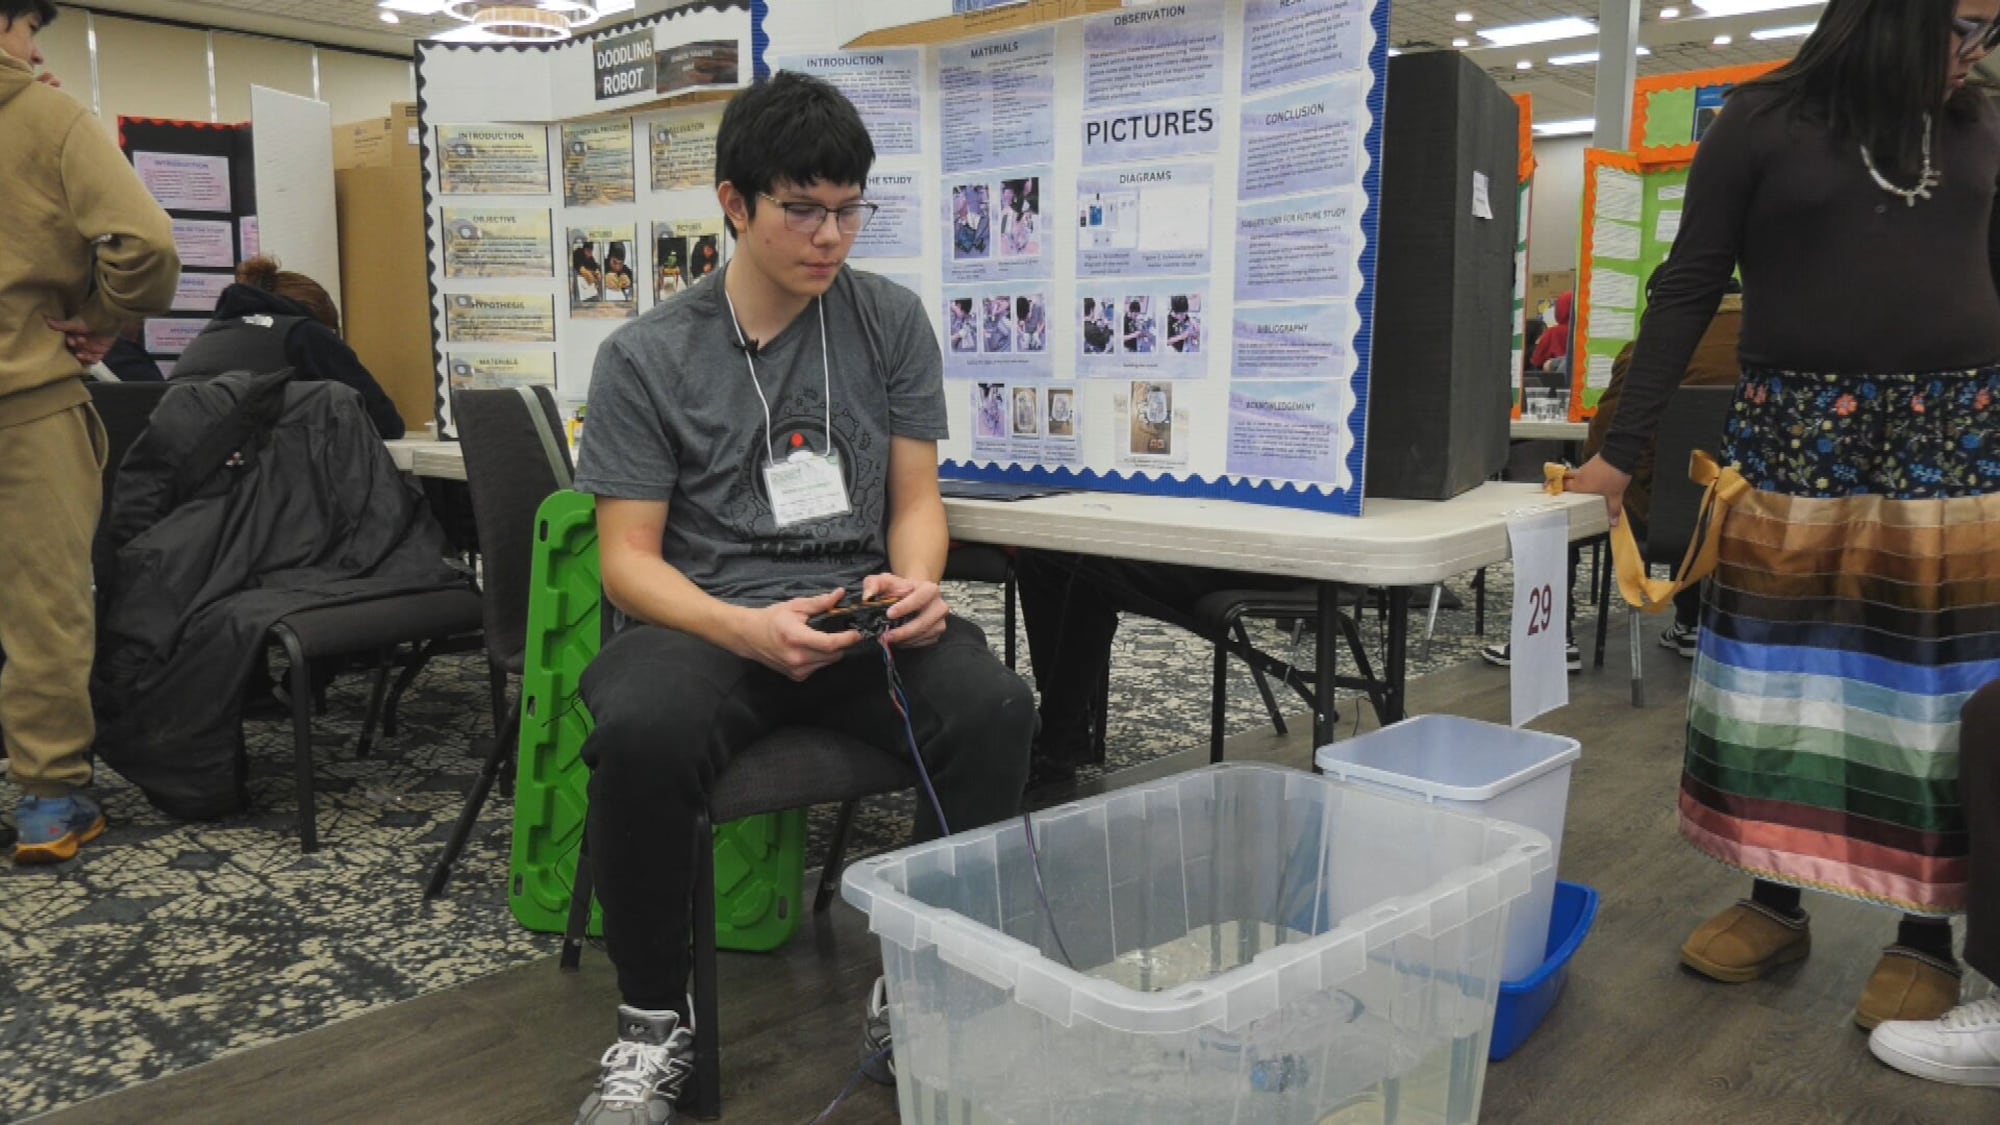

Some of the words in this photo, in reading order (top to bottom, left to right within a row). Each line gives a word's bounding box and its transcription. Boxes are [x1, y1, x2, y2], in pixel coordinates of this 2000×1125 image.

[1114, 6, 1185, 26] OBSERVATION
[597, 39, 652, 70] DOODLING
[971, 42, 1018, 58] MATERIALS
[807, 56, 884, 67] INTRODUCTION
[603, 67, 644, 95] ROBOT
[1265, 103, 1324, 125] CONCLUSION
[1087, 108, 1214, 145] PICTURES
[458, 132, 524, 140] INTRODUCTION
[1119, 171, 1172, 184] DIAGRAMS
[473, 215, 517, 224] OBJECTIVE
[1297, 210, 1321, 221] FUTURE
[1323, 208, 1346, 218] STUDY
[472, 301, 525, 310] HYPOTHESIS
[1257, 324, 1308, 334] BIBLIOGRAPHY
[478, 358, 518, 366] MATERIALS
[1527, 583, 1552, 636] 29
